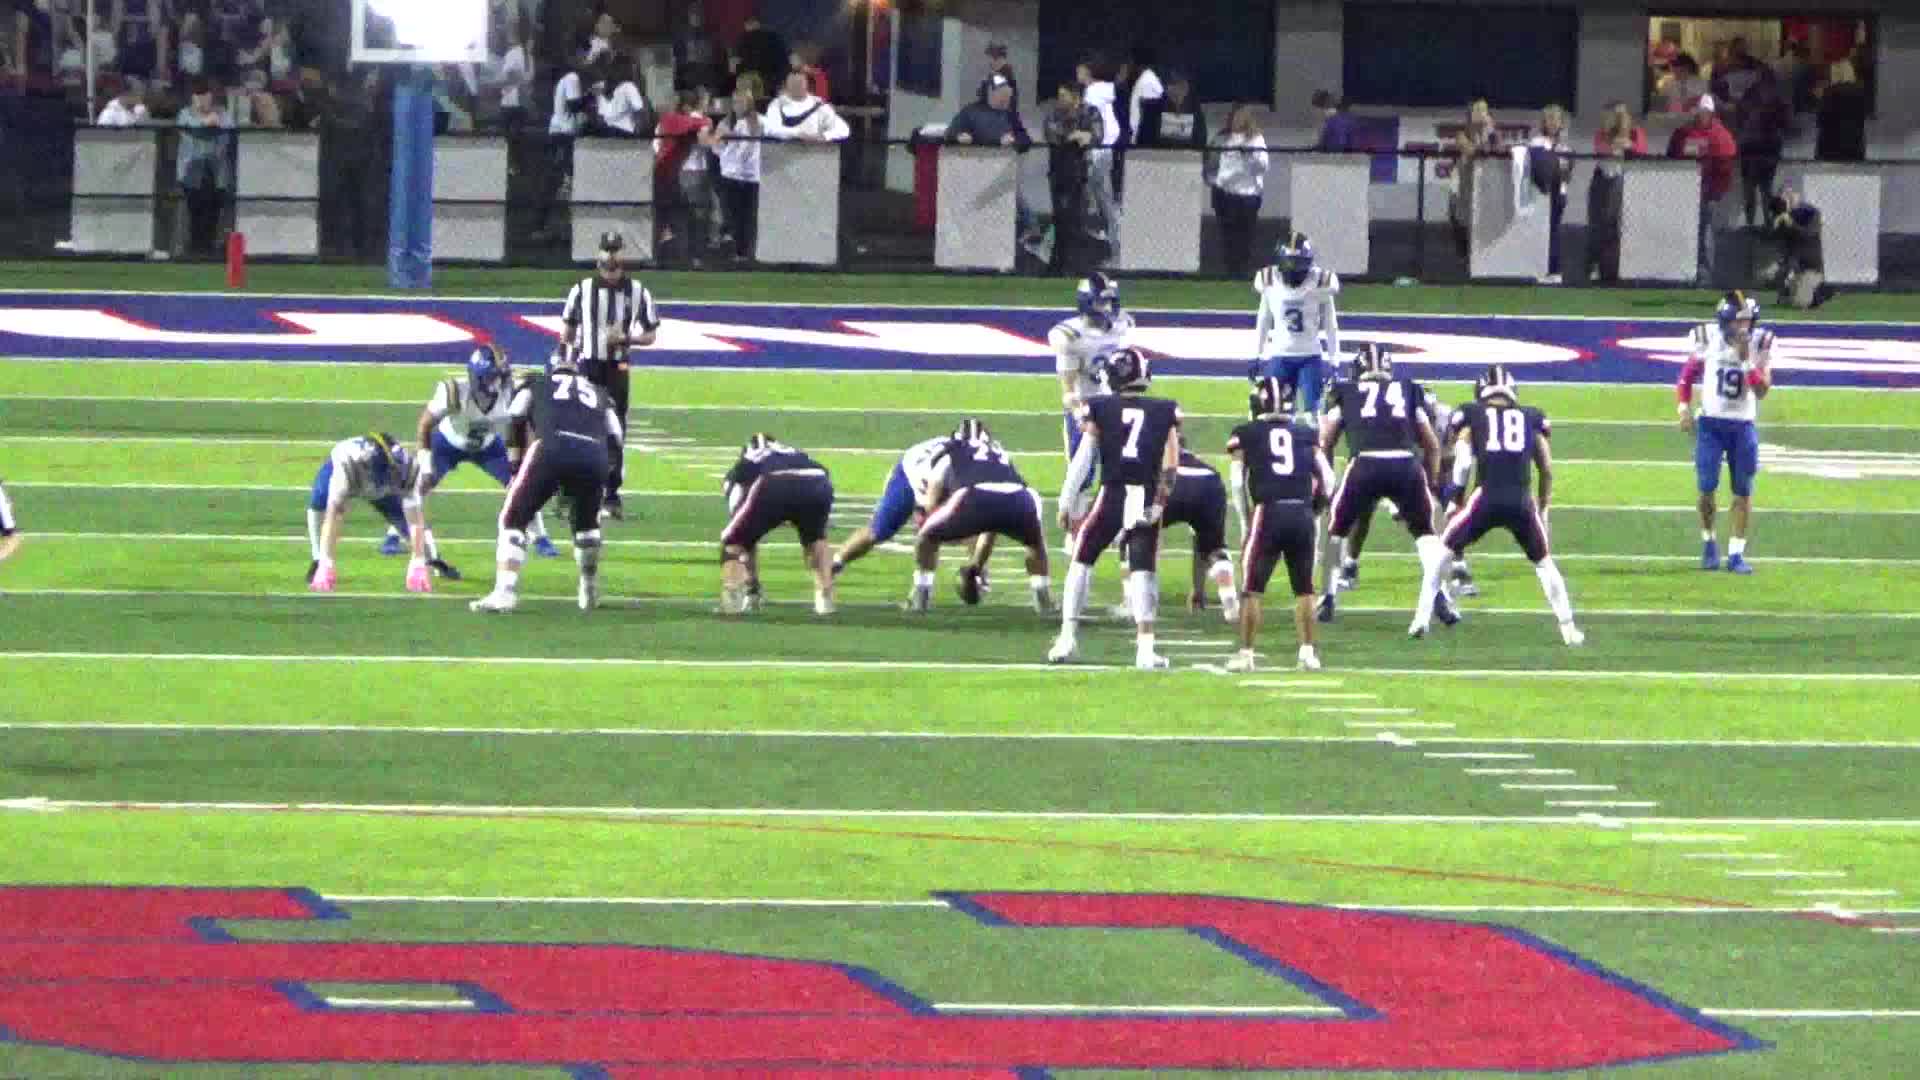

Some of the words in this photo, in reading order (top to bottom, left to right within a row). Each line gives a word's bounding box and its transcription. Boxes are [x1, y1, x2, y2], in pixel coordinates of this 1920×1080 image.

[1284, 308, 1304, 333] 3
[551, 373, 599, 409] 75
[1358, 381, 1406, 418] 74
[1716, 367, 1745, 400] 19
[1121, 408, 1145, 458] 7
[1485, 407, 1525, 452] 18
[1269, 428, 1294, 475] 9
